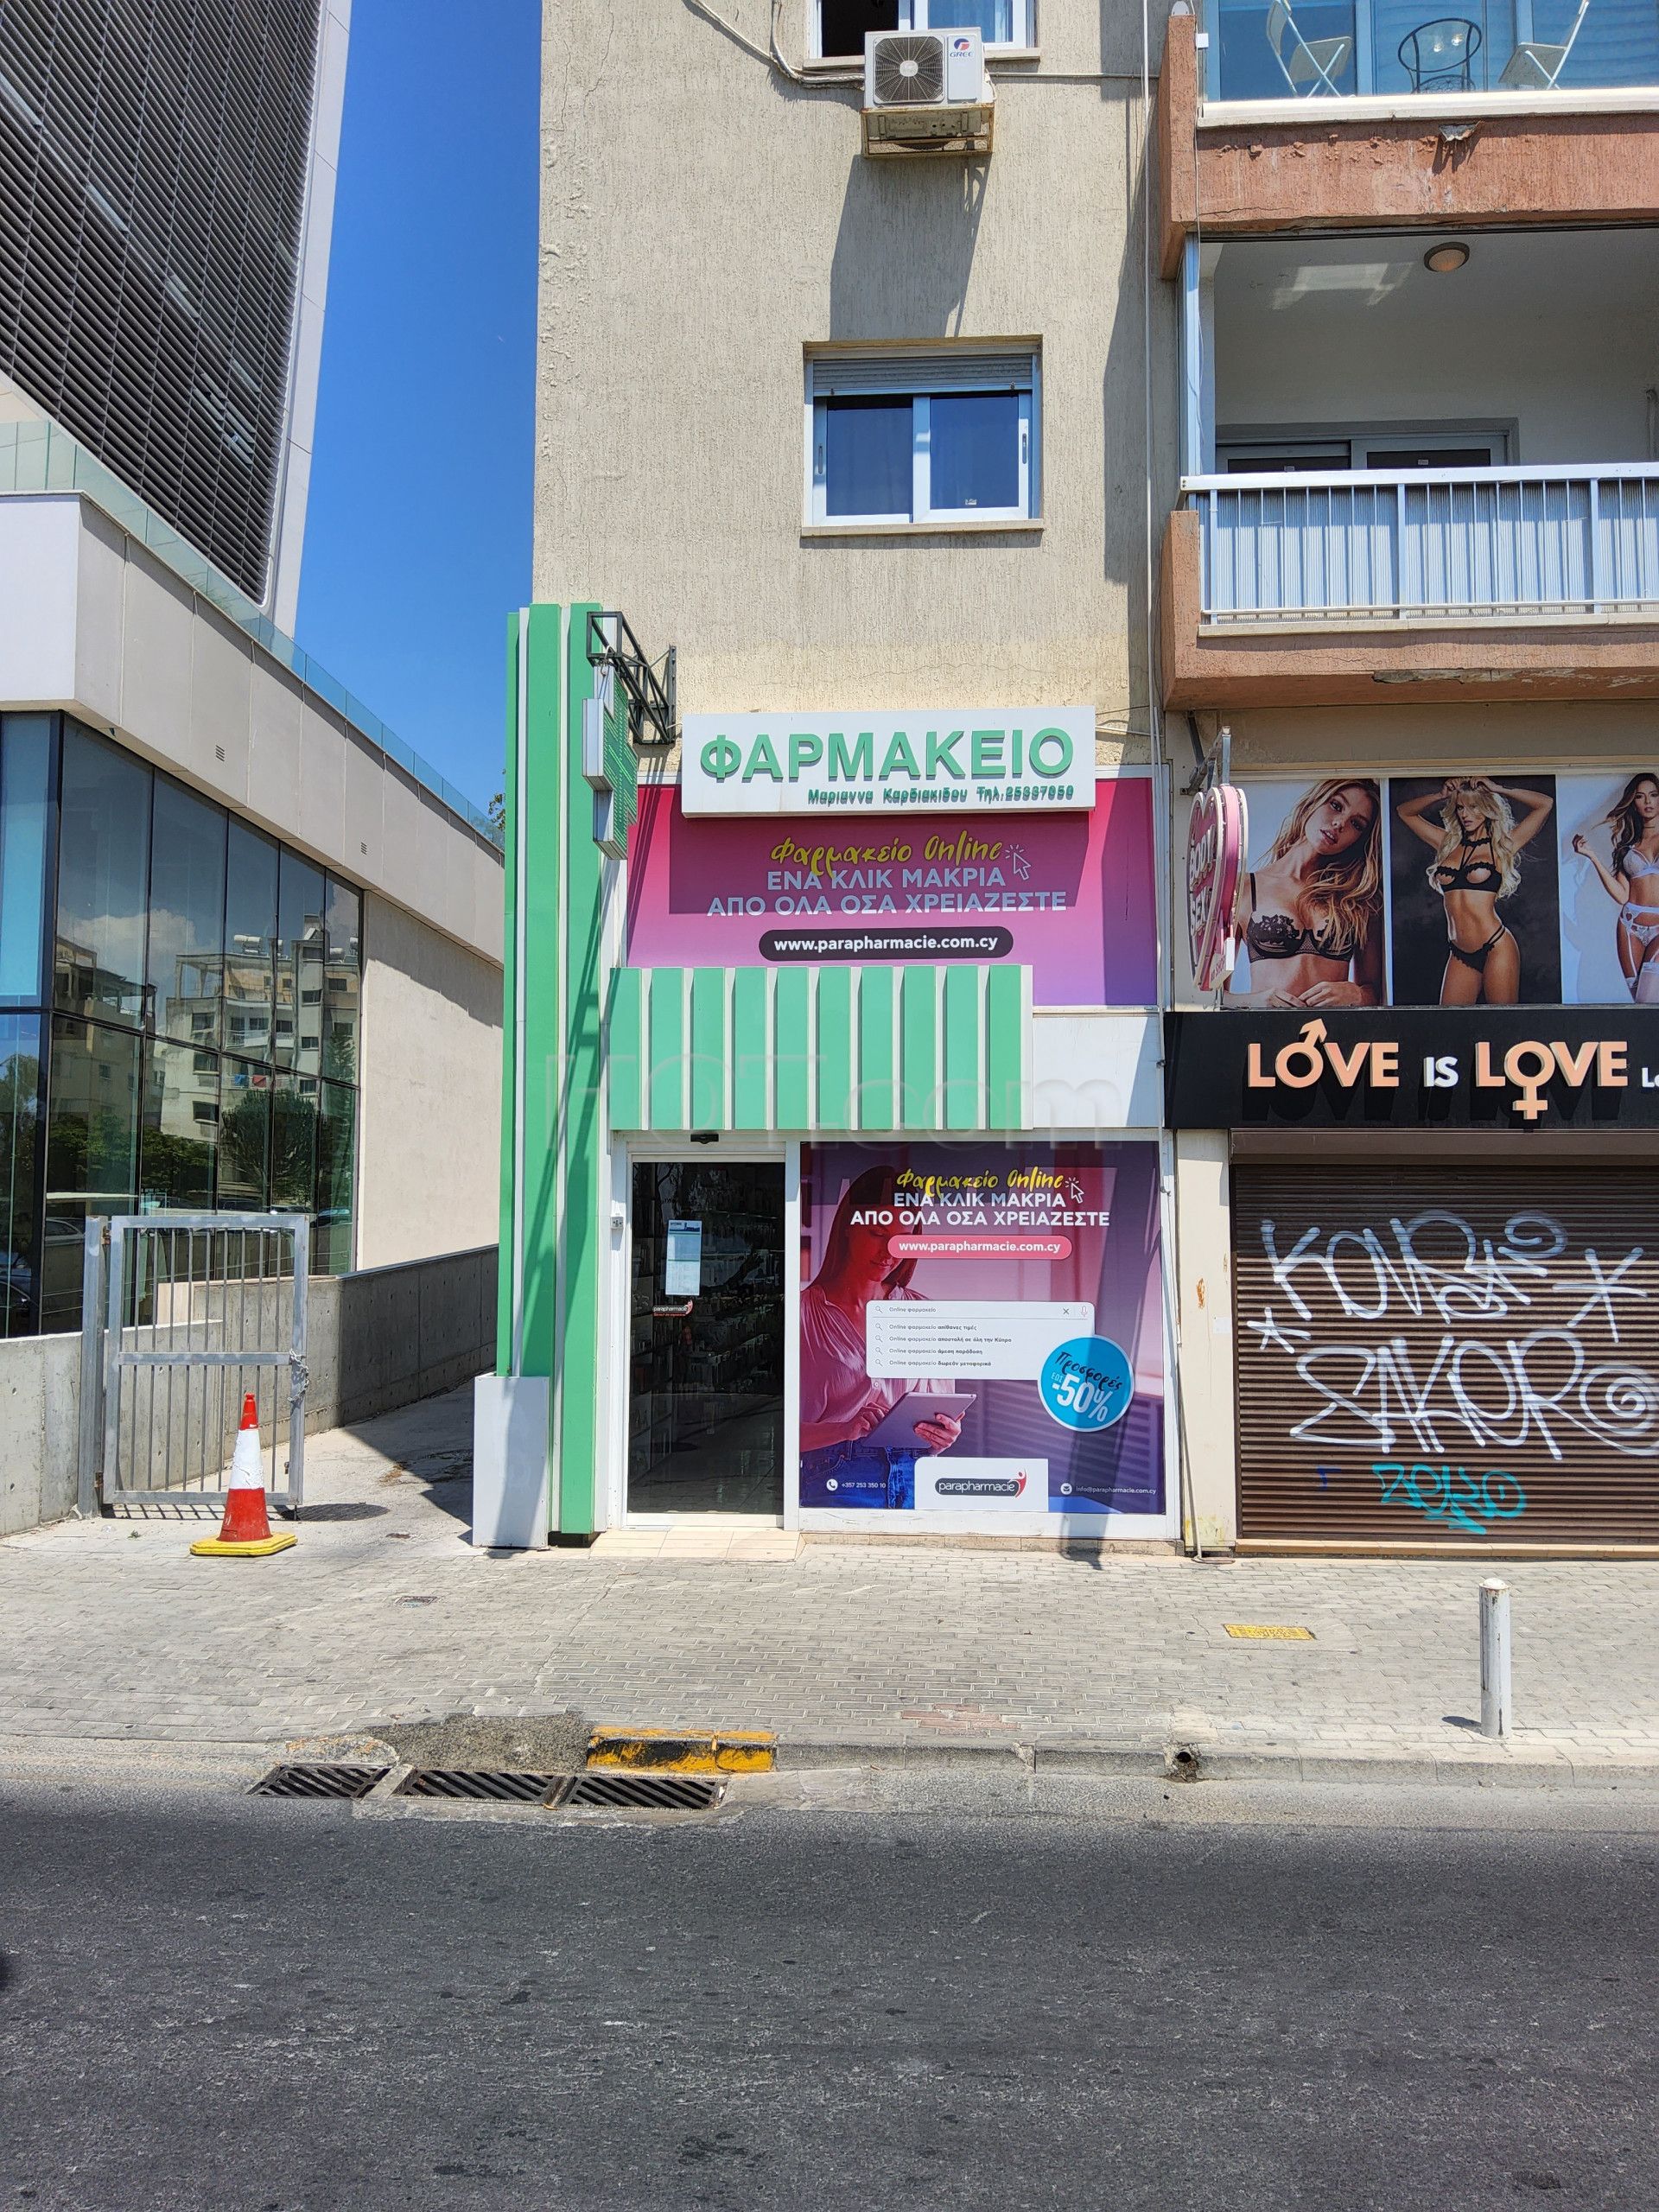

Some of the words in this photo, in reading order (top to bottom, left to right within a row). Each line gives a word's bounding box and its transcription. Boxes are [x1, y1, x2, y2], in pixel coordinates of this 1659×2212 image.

[700, 728, 1074, 783] ΦΑΡΜΑΚΕΙΟ
[808, 788, 874, 807] Μαριαννα
[883, 786, 969, 806] Καρδιακιδου
[772, 836, 912, 879] Φαρμακείο
[924, 830, 1003, 866] Online
[767, 870, 822, 890] ΕΝΑ
[831, 868, 893, 889] ΚΛΙΚ
[902, 867, 1006, 888] ΜΑΚΡΙΑ
[707, 897, 766, 917] ΑΠΟ
[775, 895, 832, 916] ΟΛΑ
[841, 894, 897, 915] ΟΣΑ
[906, 891, 1066, 913] ΧΡΕΙΑΖΕΣΤΕ
[774, 935, 998, 952] www.parapharmacie.com.cy
[1247, 1019, 1399, 1088] LOVE
[1423, 1056, 1459, 1088] IS
[1475, 1039, 1629, 1120] LOVE
[897, 1168, 998, 1199] Φαρμακείο
[1007, 1166, 1065, 1195] Online
[894, 1192, 937, 1207] ΕΝΑ
[940, 1192, 985, 1207] ΚΛΙΚ
[991, 1192, 1066, 1208] ΜΑΚΡΙΑ
[850, 1211, 893, 1225] ΑΠΟ
[899, 1211, 940, 1225] ΟΛΑ
[946, 1211, 988, 1225] ΟΣΑ
[994, 1211, 1110, 1226] ΧΡΕΙΑΖΕΣΤΕ
[899, 1240, 1061, 1254] www.parapharmacie.com.cy
[1055, 1351, 1122, 1391] Προσφορές
[1052, 1373, 1113, 1422] -50%
[938, 1480, 1015, 1494] parapharmacie
